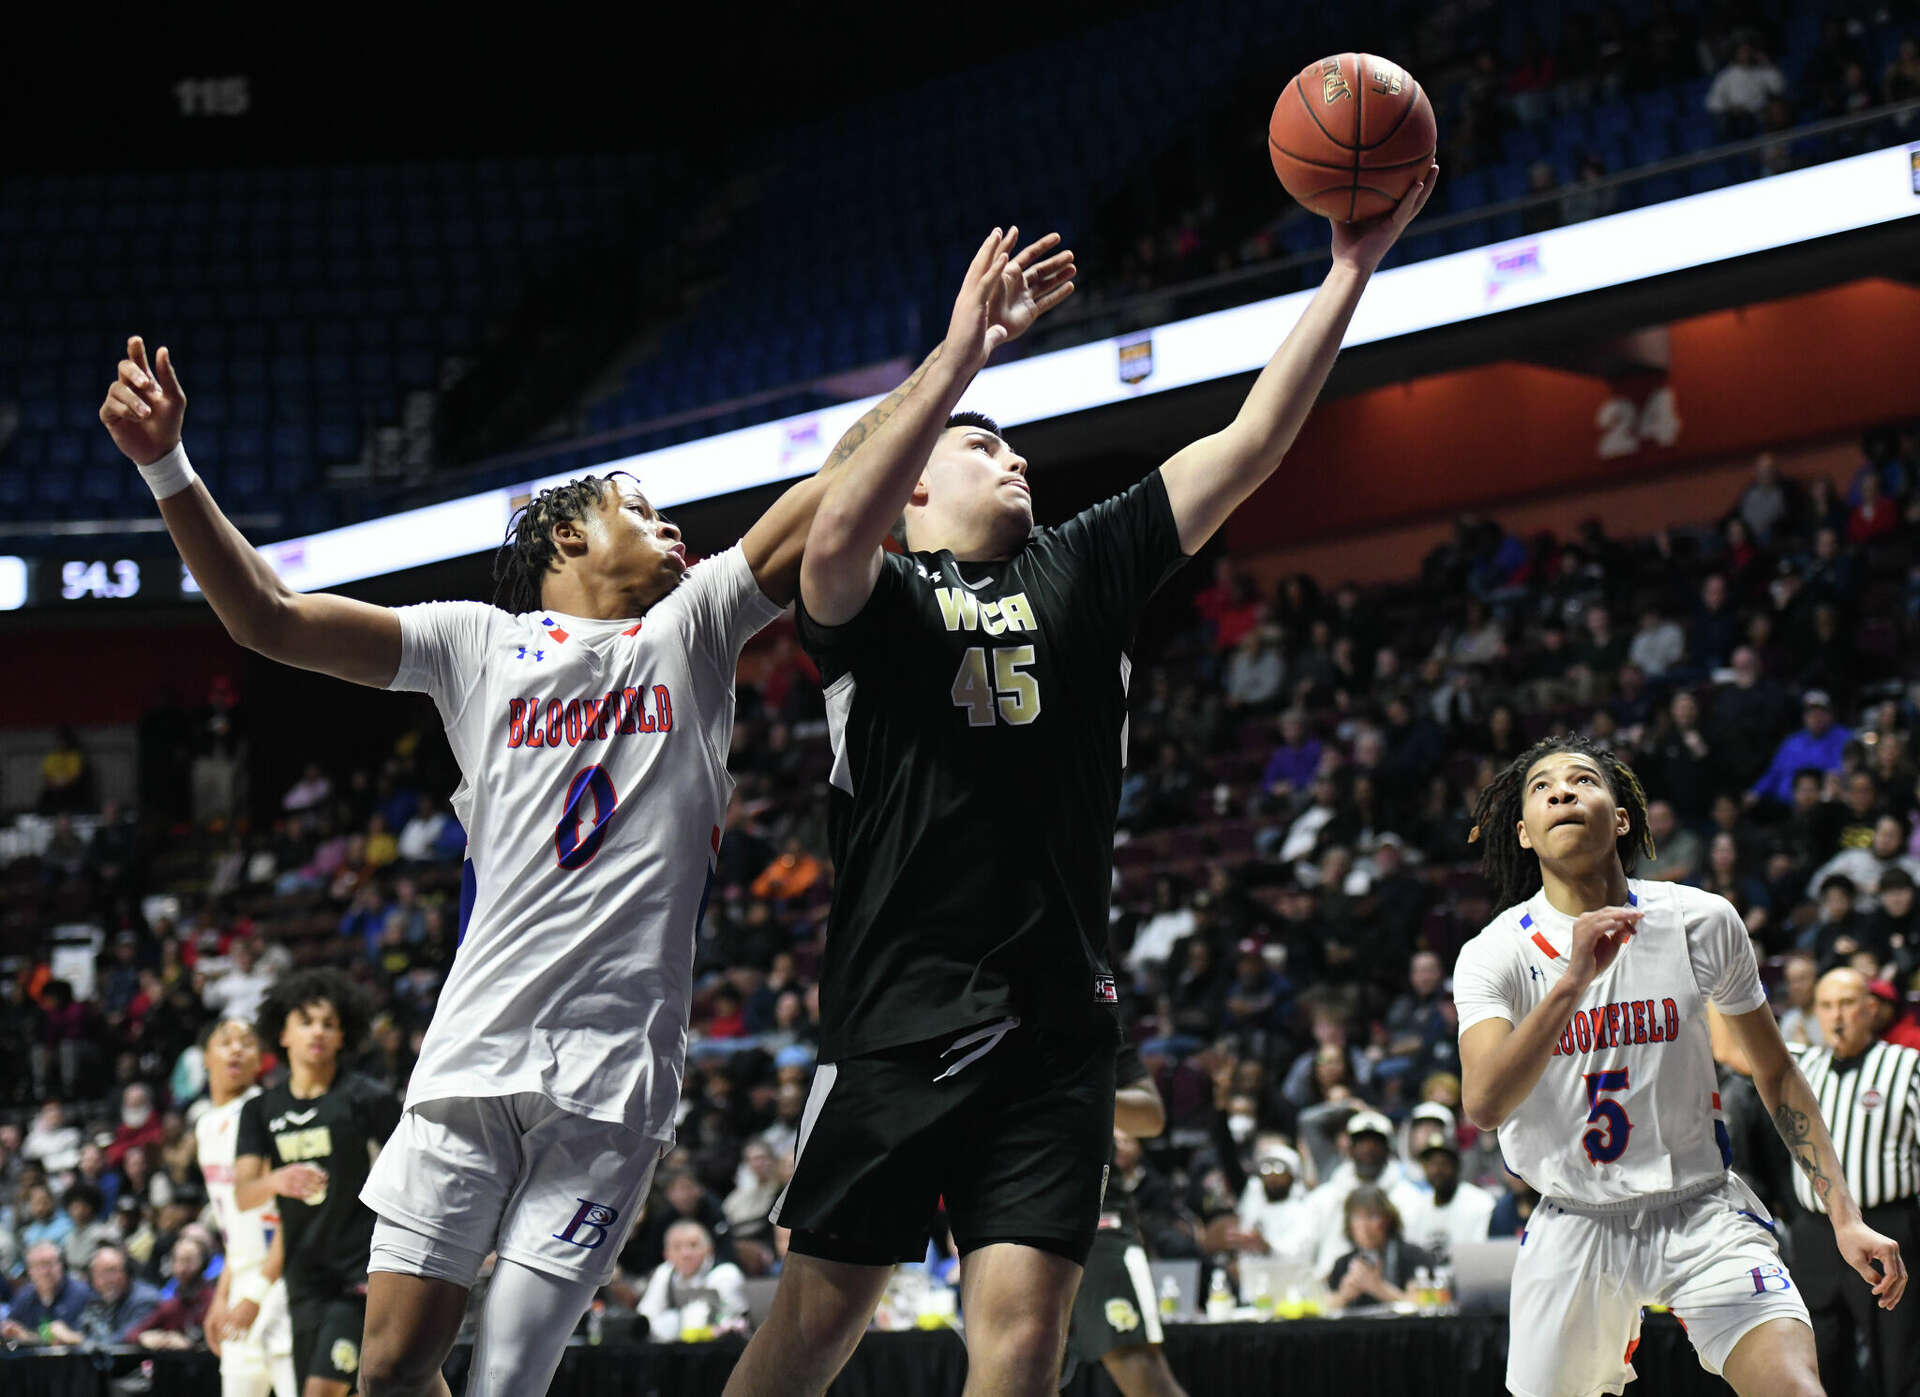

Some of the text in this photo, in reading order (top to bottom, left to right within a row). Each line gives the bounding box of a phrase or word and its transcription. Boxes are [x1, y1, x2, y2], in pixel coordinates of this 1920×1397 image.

[174, 79, 248, 116] 115
[1597, 388, 1681, 457] 24
[62, 559, 140, 599] 54.3
[935, 588, 1038, 636] WCA
[951, 645, 1041, 727] 45
[555, 763, 618, 870] 0
[1552, 998, 1679, 1056] OOMFIELD
[1582, 1066, 1635, 1167] 5
[552, 1198, 618, 1249] B
[1745, 1263, 1790, 1297] B
